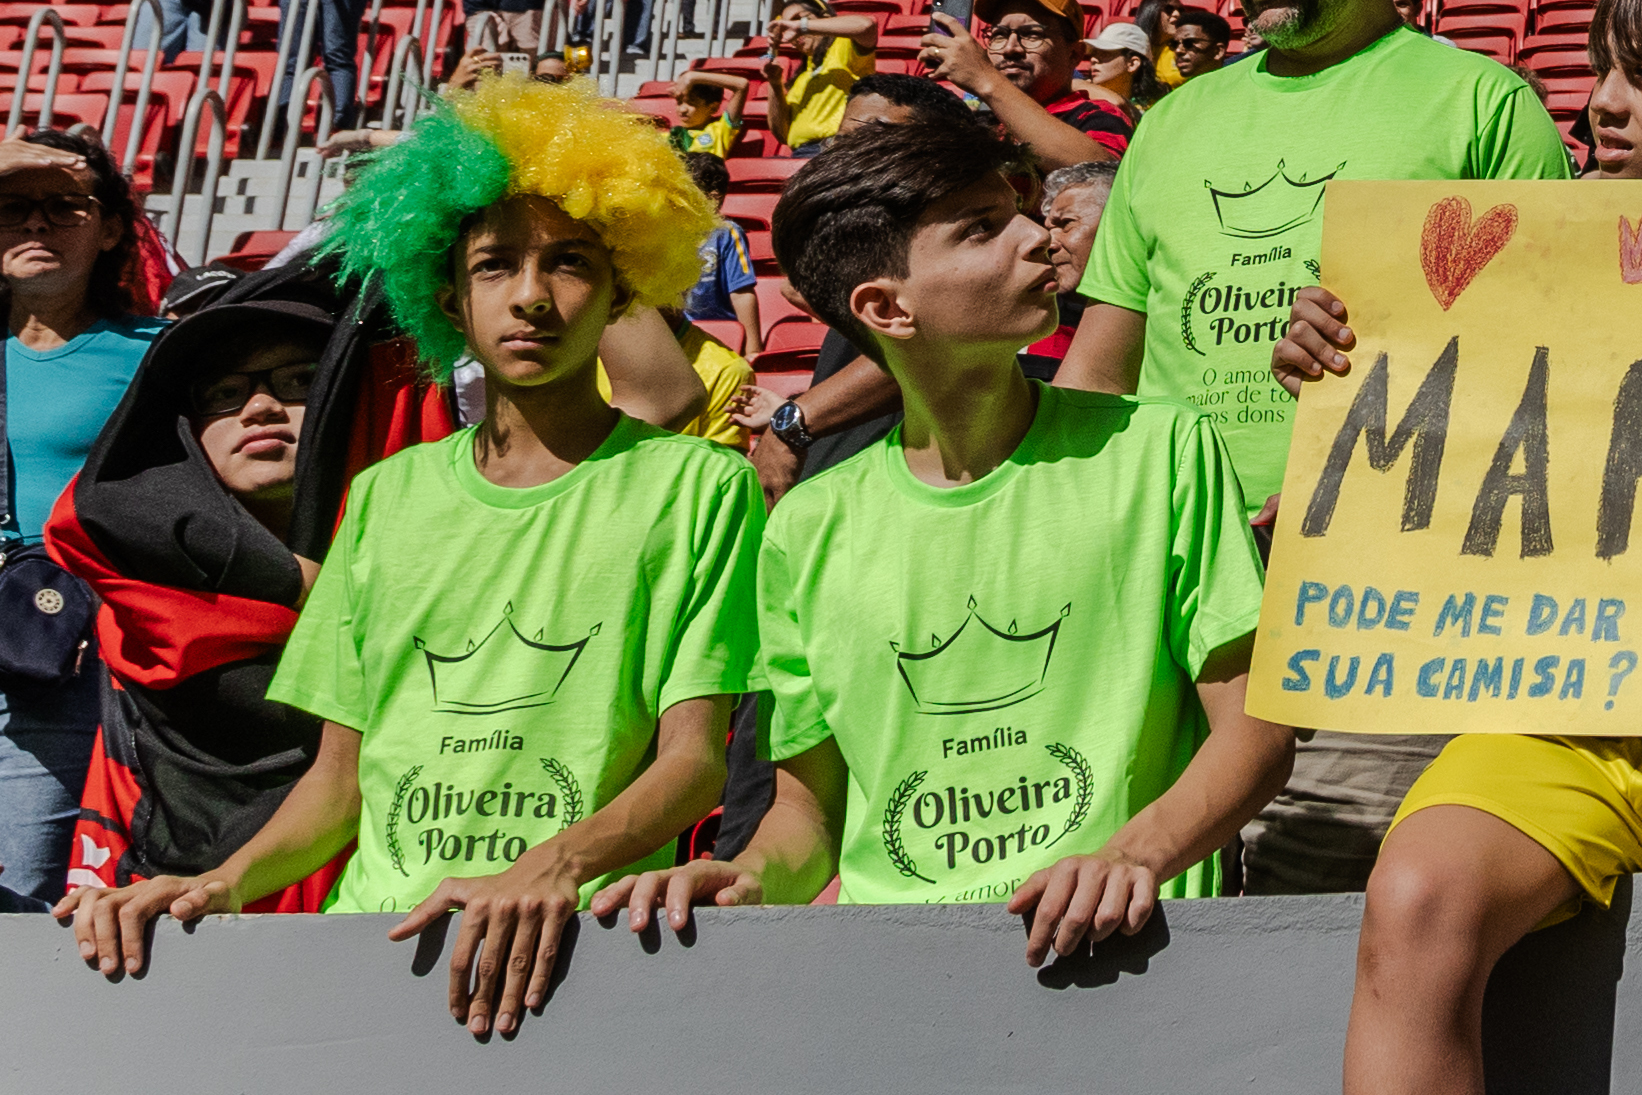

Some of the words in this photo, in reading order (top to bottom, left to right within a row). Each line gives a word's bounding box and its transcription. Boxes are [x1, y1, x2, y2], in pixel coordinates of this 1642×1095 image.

[1231, 245, 1292, 267] Família
[1200, 281, 1302, 315] Oliveir
[1236, 385, 1261, 404] de
[1237, 405, 1285, 424] dons
[1294, 580, 1420, 632] PODE
[1433, 591, 1509, 638] ME
[1525, 592, 1627, 643] DAR
[1281, 649, 1395, 700] SUA
[439, 729, 524, 755] Família
[942, 726, 1027, 759] Família
[407, 782, 558, 824] Oliveira
[913, 776, 1073, 829] Oliveira
[418, 828, 527, 866] Porto
[934, 823, 1050, 869] Porto
